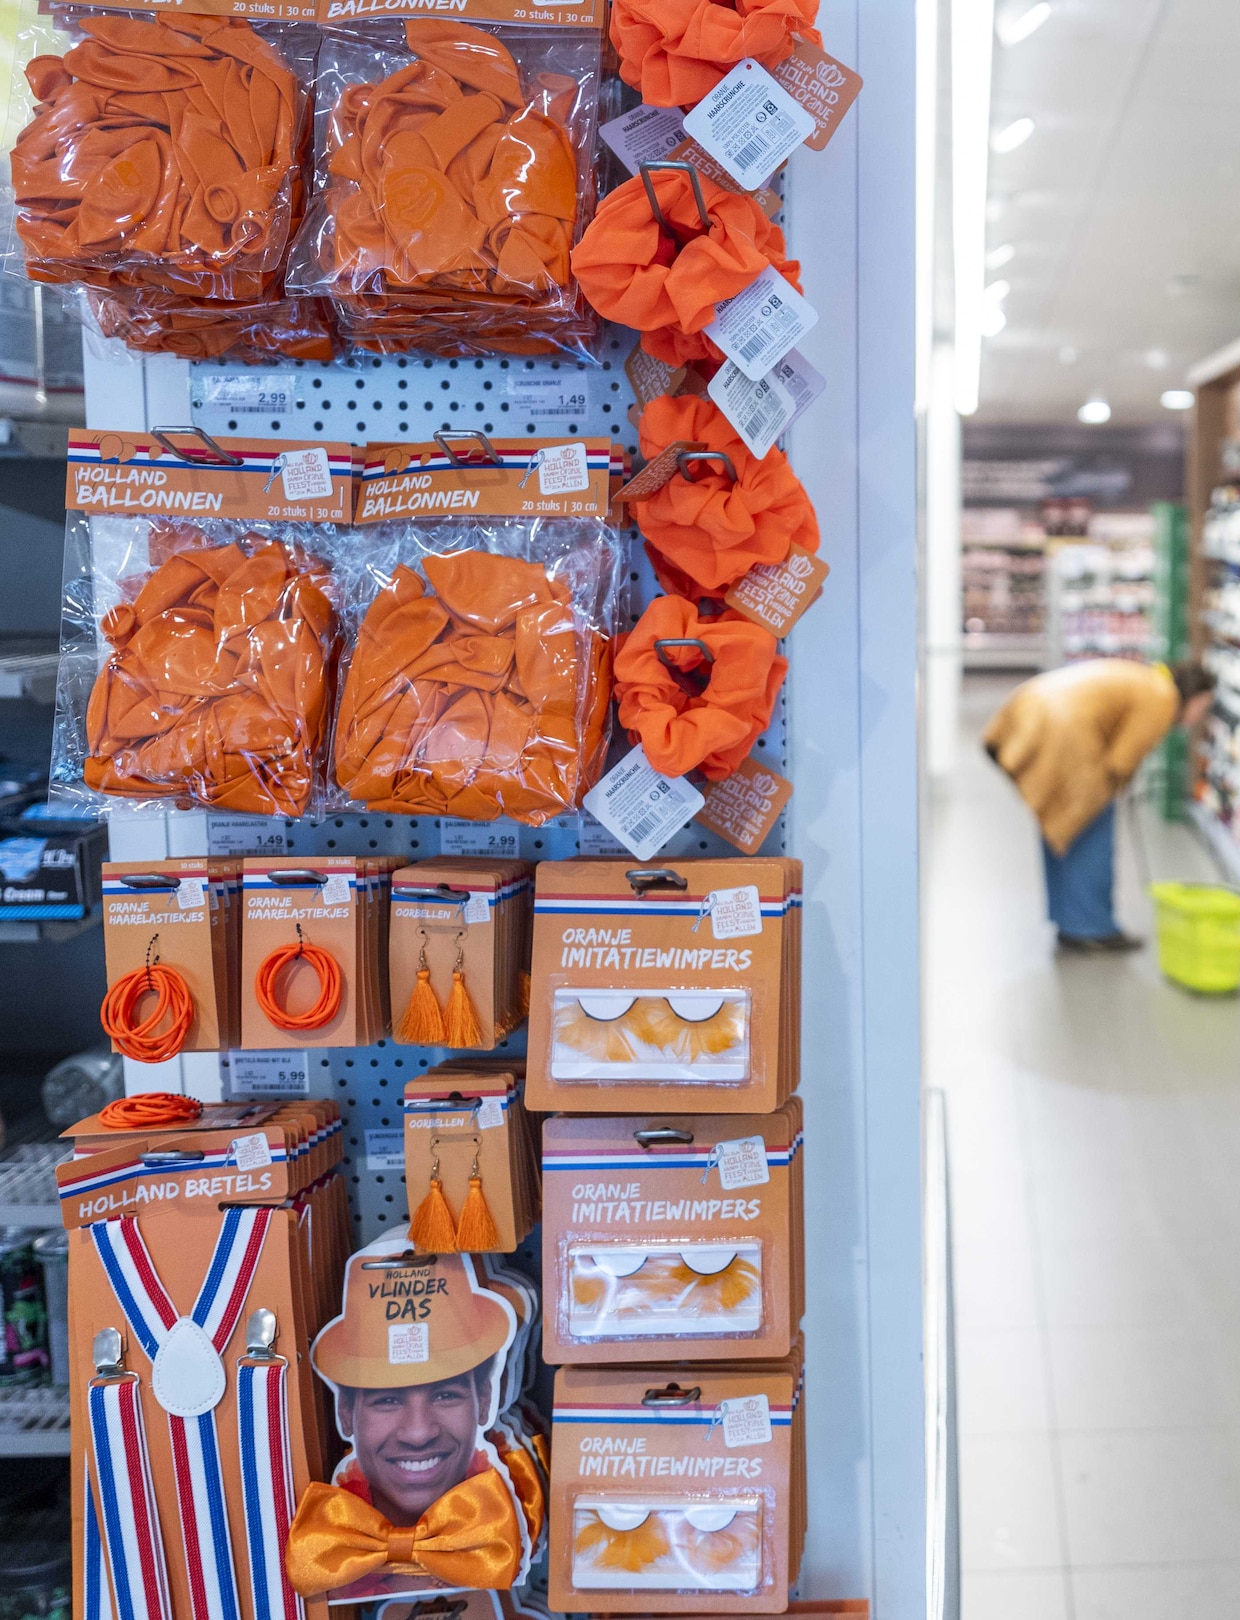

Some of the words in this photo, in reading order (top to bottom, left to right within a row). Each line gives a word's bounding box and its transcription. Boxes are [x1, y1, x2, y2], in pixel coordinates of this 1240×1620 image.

[233, 2, 246, 12] 20
[249, 3, 275, 15] stuks
[286, 6, 299, 16] 30
[301, 8, 315, 17] cm
[513, 8, 525, 18] 20
[529, 9, 555, 21] stuks
[565, 13, 578, 23] 30
[580, 15, 594, 23] cm
[775, 62, 839, 106] HOLLAND
[707, 81, 746, 119] HAARSCRUNCHIE
[711, 84, 730, 102] ORANJE
[258, 392, 286, 404] 2,99
[559, 394, 586, 405] 1,49
[287, 464, 323, 477] HOLLAND
[544, 459, 580, 472] HOLLAND
[78, 467, 167, 486] HOLLAND
[366, 475, 432, 497] HOLLAND
[76, 484, 223, 511] BALLONNEN
[361, 489, 480, 518] BALLONNEN
[521, 501, 534, 511] 20
[536, 500, 561, 511] stuks
[570, 501, 582, 512] 30
[585, 503, 598, 512] cm
[267, 505, 280, 516] 20
[283, 505, 307, 517] stuks
[317, 508, 328, 519] 30
[330, 509, 343, 519] cm
[754, 603, 785, 629] ALLEN
[605, 763, 641, 798] HAARSCRUNCHIE
[720, 778, 772, 813] HOLLAND
[256, 835, 283, 846] 1,49
[488, 835, 516, 846] 2,99
[723, 820, 754, 846] ALLEN
[108, 902, 150, 913] ORANJE
[247, 897, 292, 908] ORANJE
[109, 911, 205, 926] HAARELASTIEKJES
[247, 908, 350, 920] HAARELASTIEKJES
[395, 908, 451, 920] OORBELLEN
[562, 928, 632, 945] ORANJE
[561, 947, 752, 972] IMITATIEWIMPERS
[278, 1071, 305, 1082] 5,99
[409, 1118, 465, 1129] OORBELLEN
[78, 1181, 179, 1219] HOLLAND
[184, 1172, 272, 1198] BRETELS
[572, 1183, 641, 1201] ORANJE
[571, 1198, 761, 1224] IMITATIEWIMPERS
[386, 1268, 430, 1280] HOLLAND
[368, 1278, 449, 1299] VLINDER
[385, 1298, 433, 1322] DAS
[579, 1436, 647, 1454] ORANJE
[578, 1455, 763, 1478] IMITATIEWIMPERS
